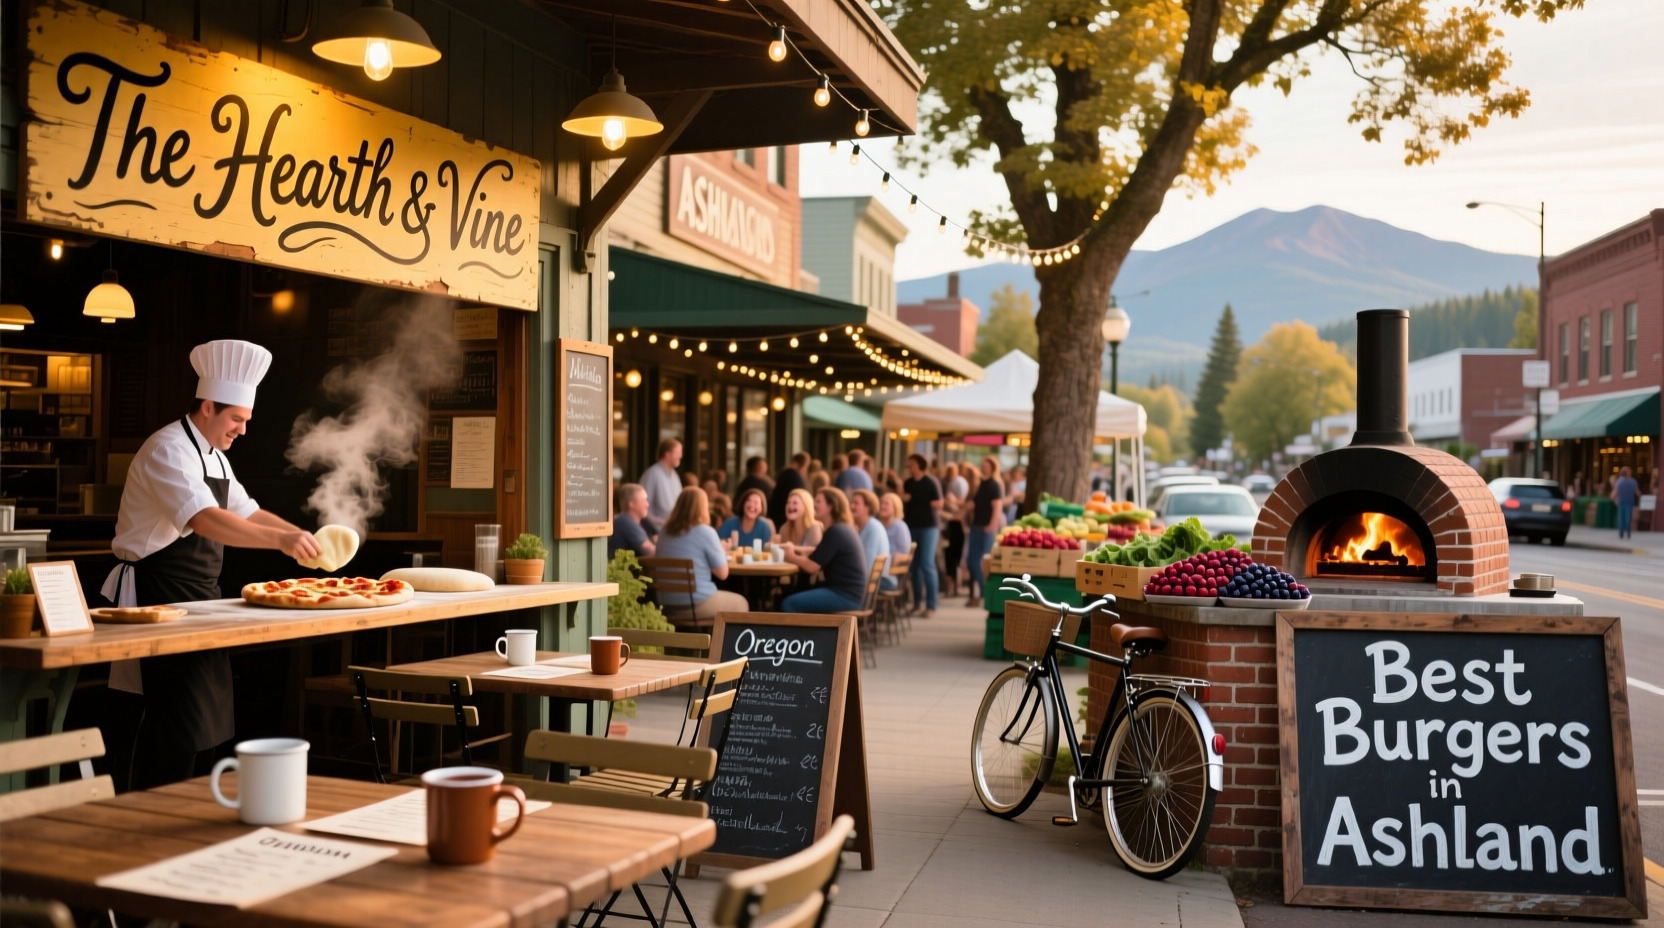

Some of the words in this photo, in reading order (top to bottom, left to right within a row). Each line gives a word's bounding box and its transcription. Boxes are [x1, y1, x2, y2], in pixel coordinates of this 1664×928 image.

[57, 52, 196, 190] The
[193, 94, 395, 228] Hearth
[401, 170, 437, 240] &
[437, 159, 525, 256] Vine
[735, 628, 815, 667] Oregon
[1364, 640, 1533, 706] Best
[1315, 697, 1592, 778] Burgers
[1429, 769, 1462, 799] in
